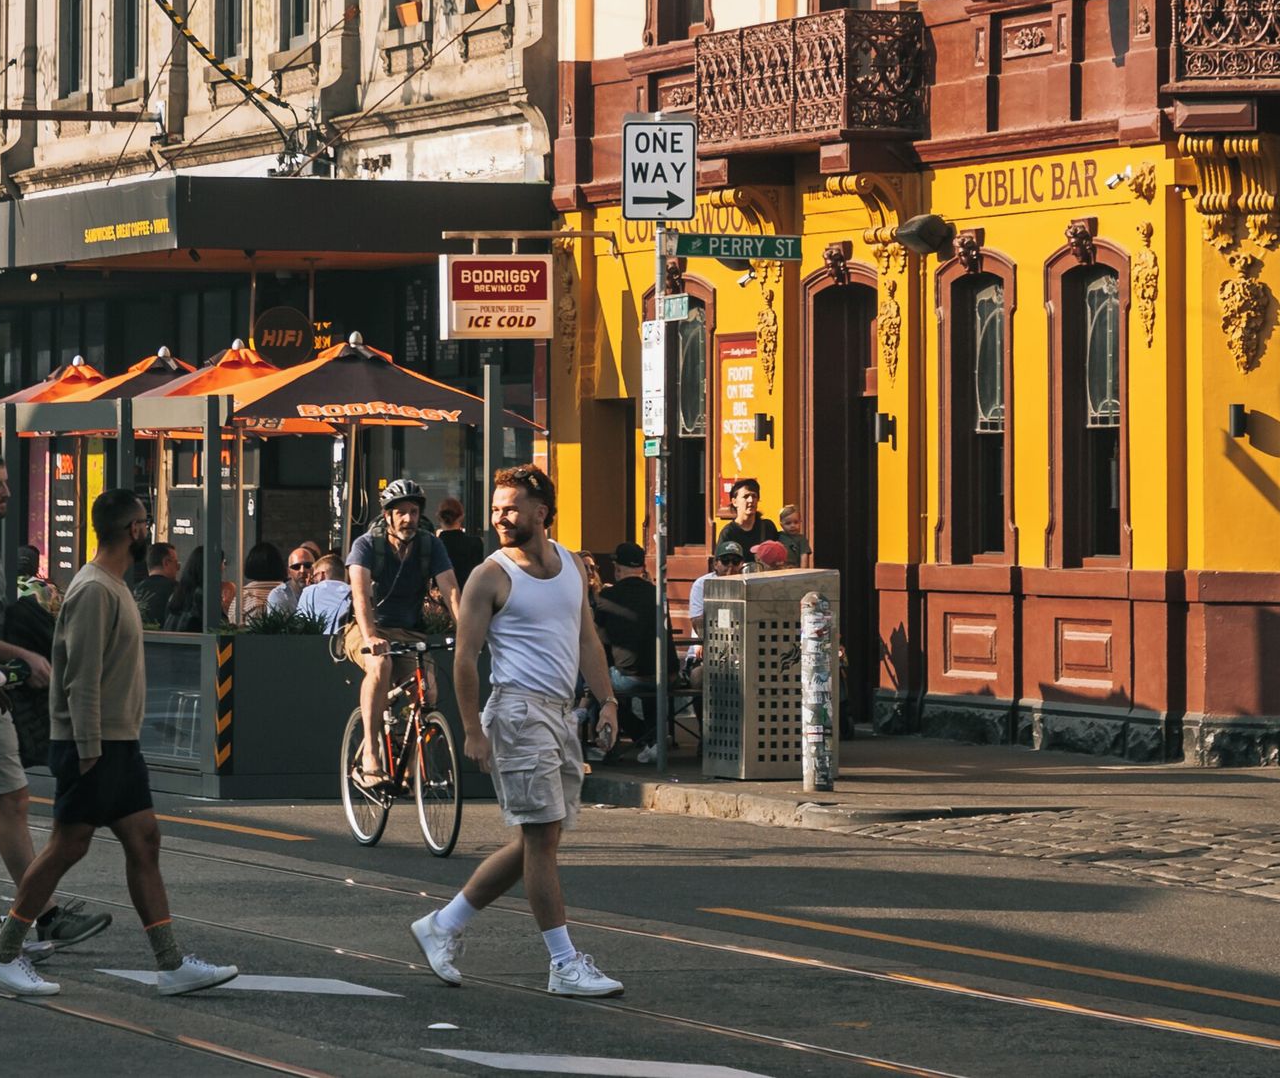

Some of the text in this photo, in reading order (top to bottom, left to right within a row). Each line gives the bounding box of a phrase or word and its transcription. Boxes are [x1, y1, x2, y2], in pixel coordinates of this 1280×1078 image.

[635, 131, 684, 154] ONE
[631, 161, 687, 184] WAY
[964, 159, 1099, 210] PUBLIC BAR
[709, 236, 795, 258] PERRY ST
[460, 269, 540, 284] BODRIGGY
[473, 284, 527, 293] BREWING CO.
[479, 305, 524, 313] POURING HERE
[467, 315, 537, 329] ICE COLD
[727, 366, 754, 382] FOOTY
[296, 400, 463, 422] BODRIGGY
[733, 401, 748, 416] BIG
